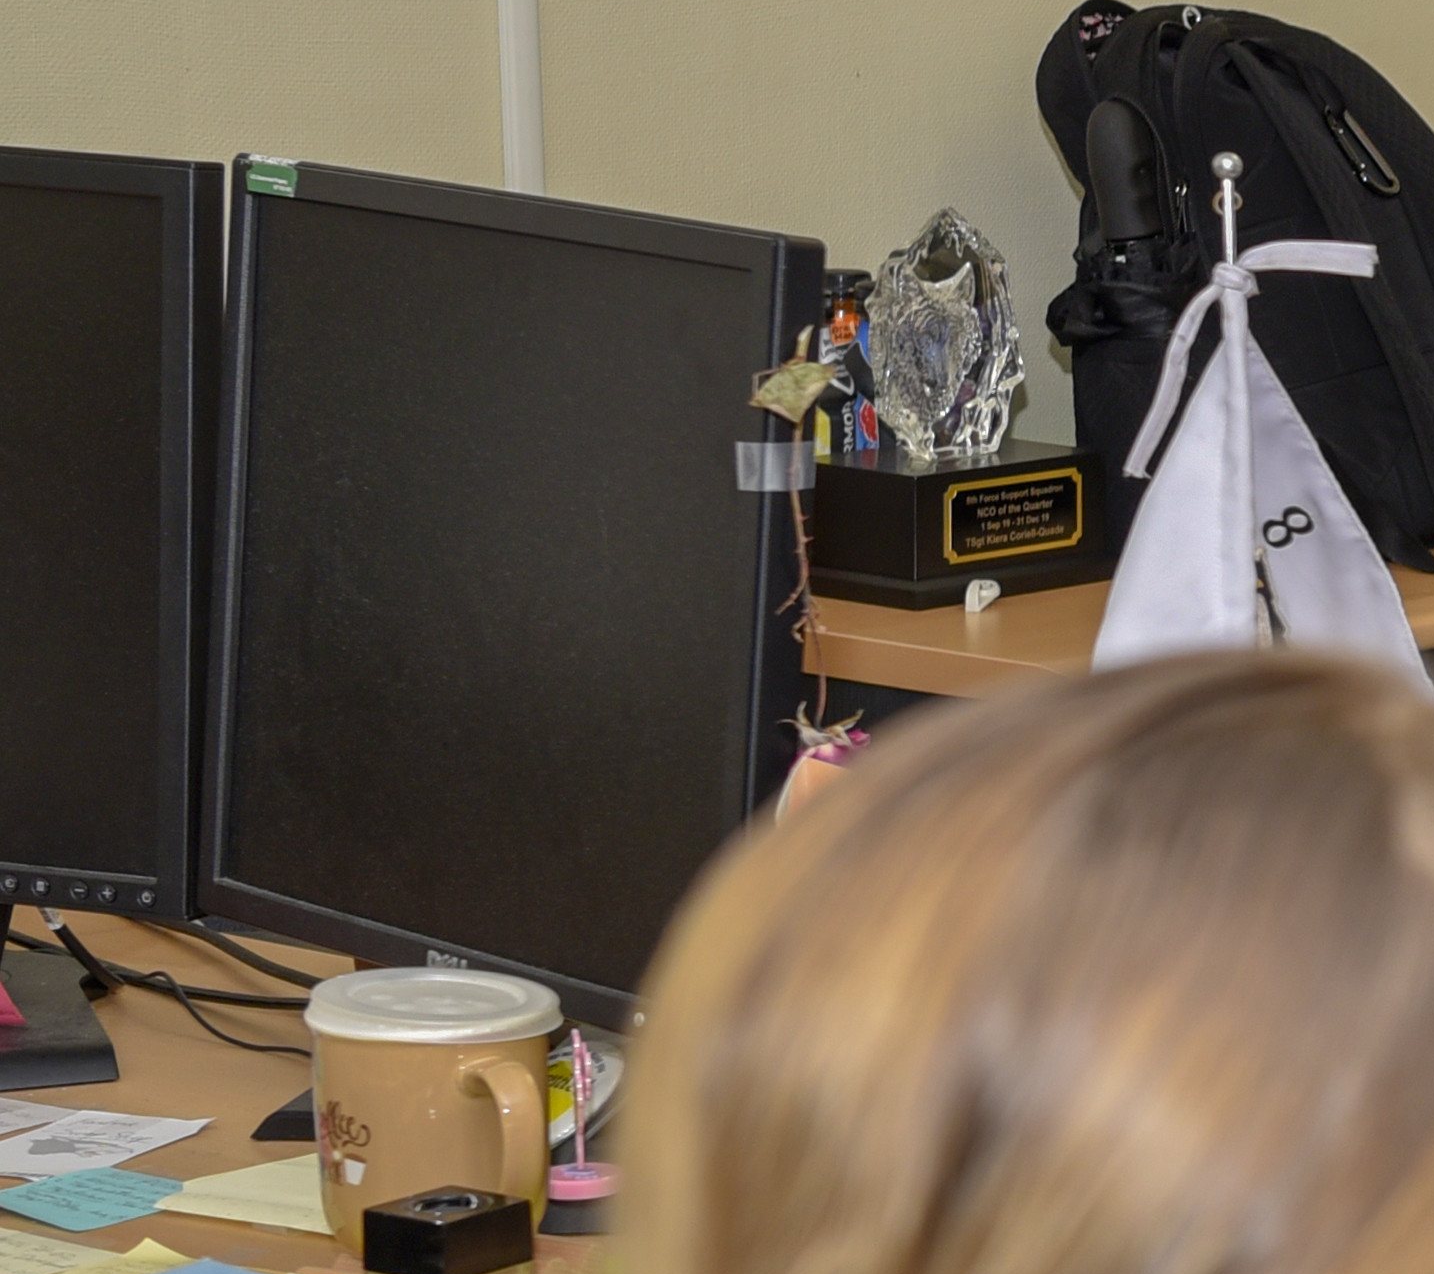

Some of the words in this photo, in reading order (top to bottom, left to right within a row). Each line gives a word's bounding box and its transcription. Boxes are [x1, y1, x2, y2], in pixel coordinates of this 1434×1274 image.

[977, 506, 996, 518] NCO
[1023, 499, 1054, 511] Quarter
[1262, 505, 1315, 549] 8
